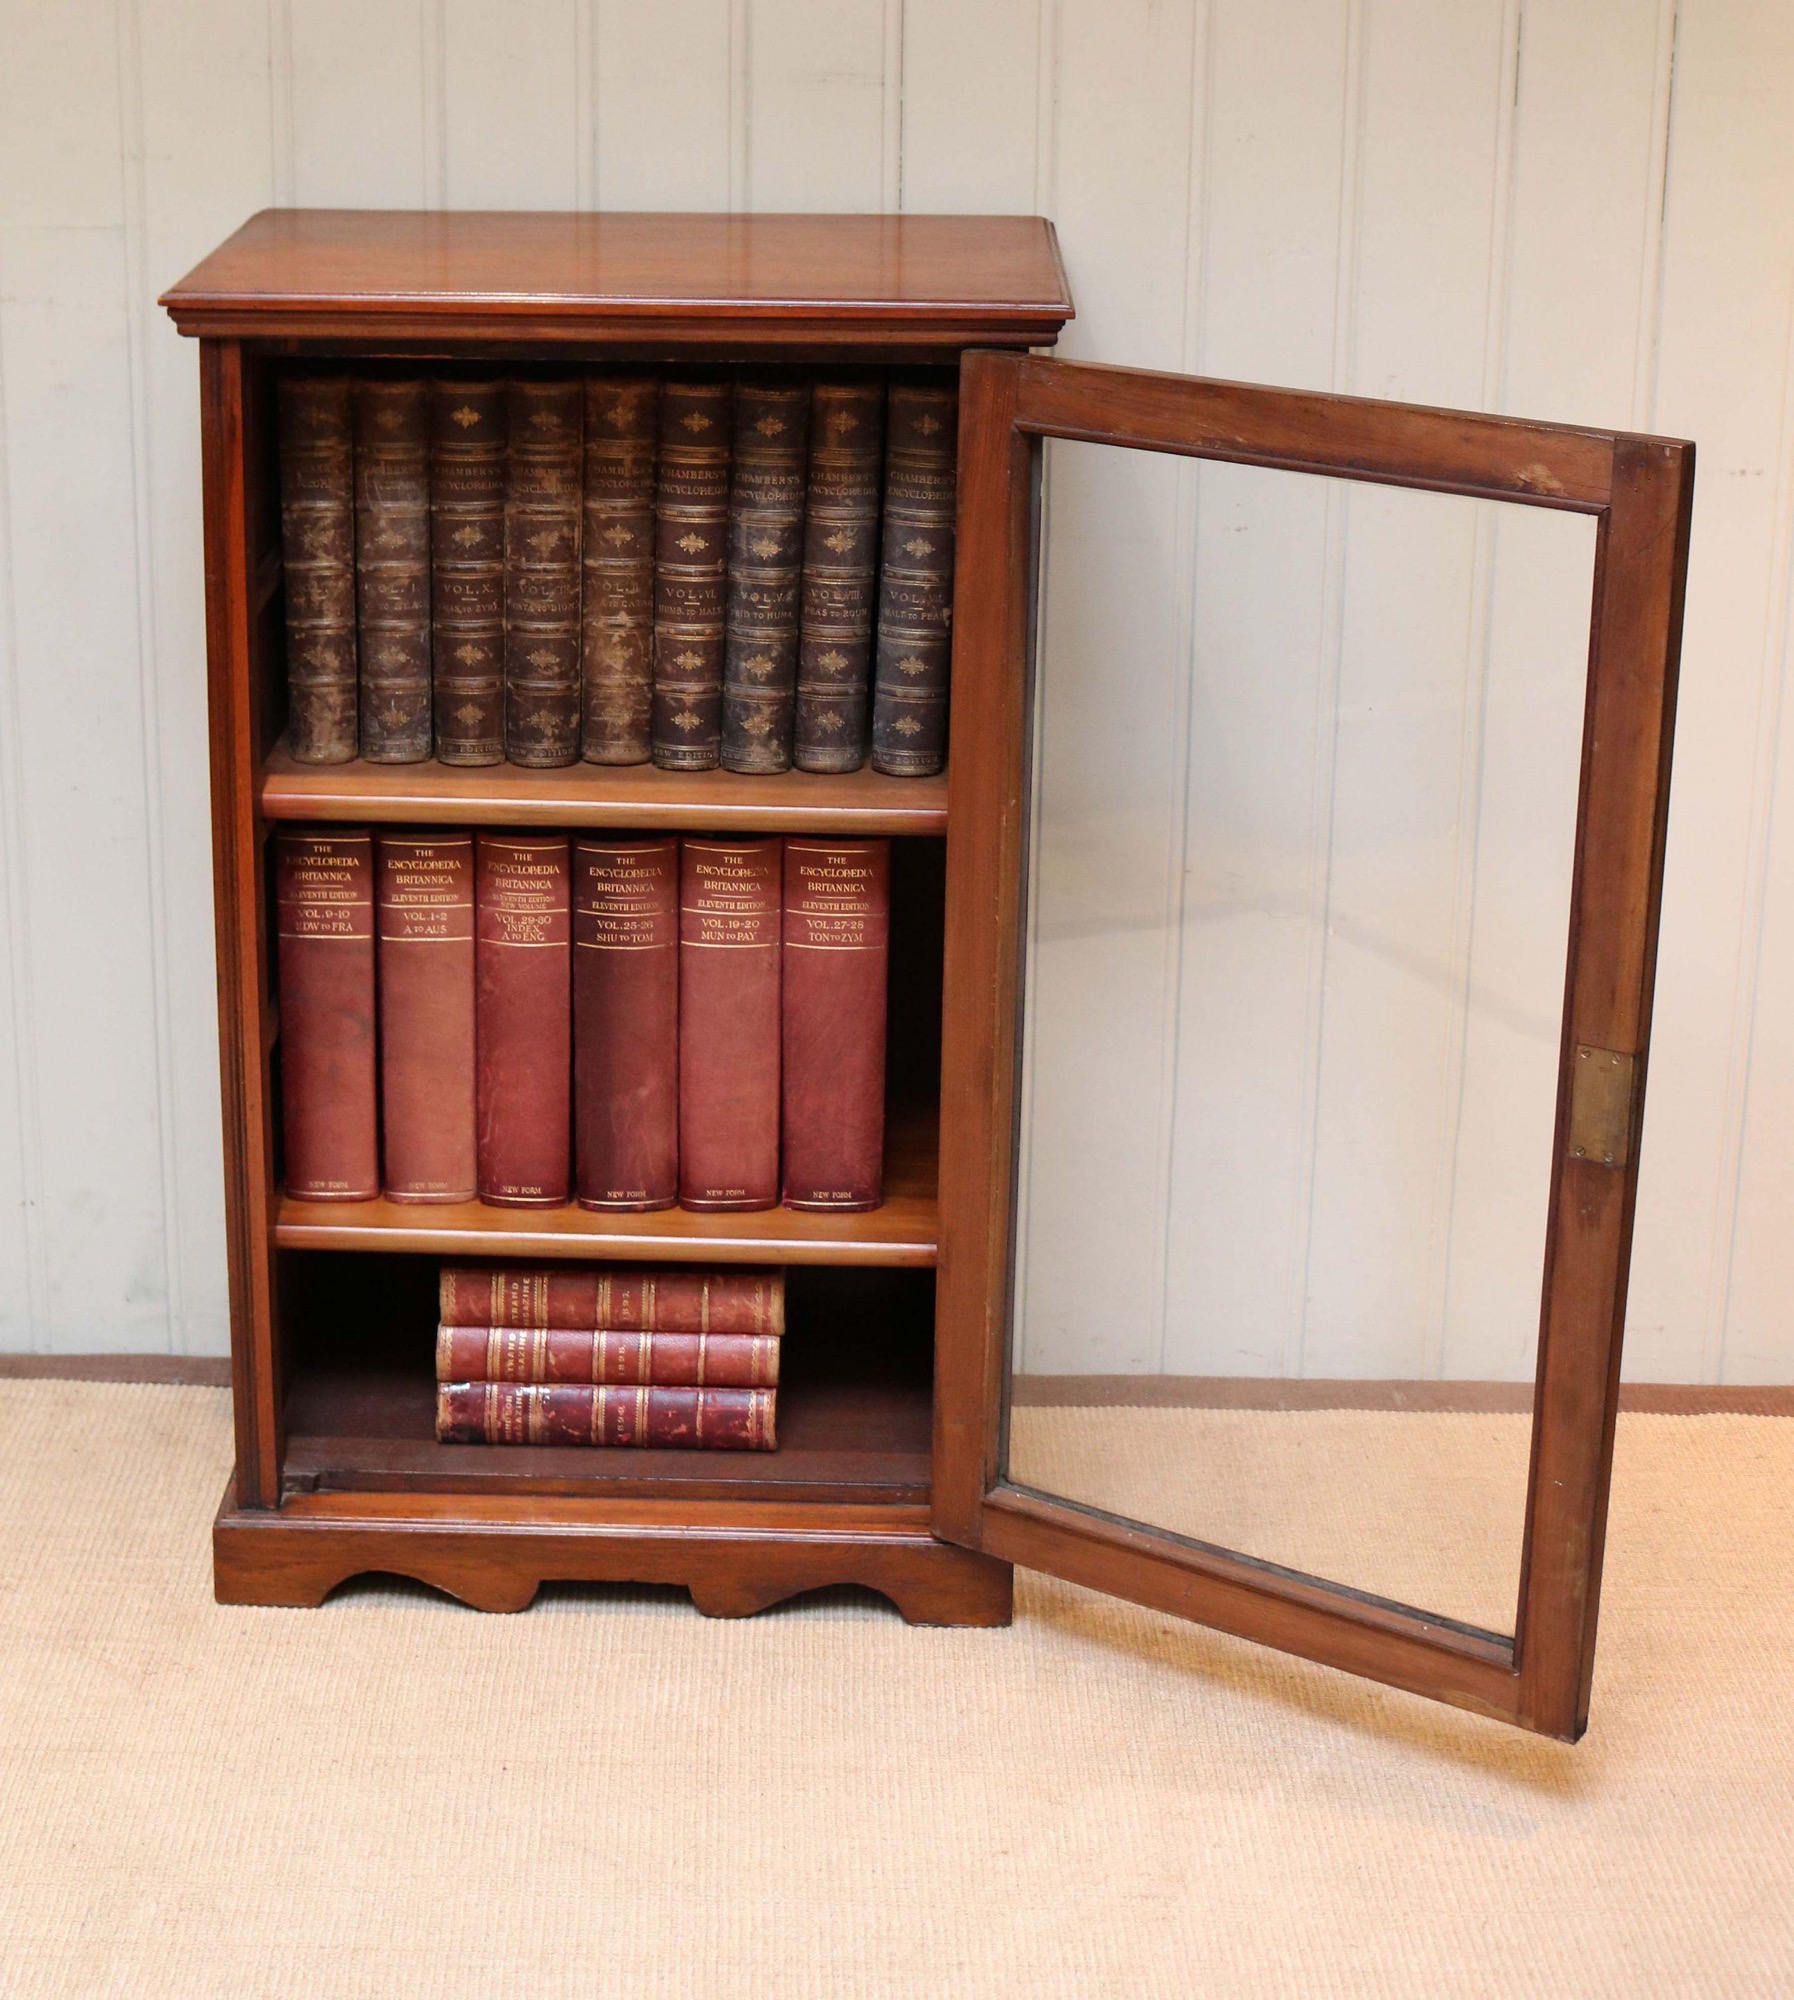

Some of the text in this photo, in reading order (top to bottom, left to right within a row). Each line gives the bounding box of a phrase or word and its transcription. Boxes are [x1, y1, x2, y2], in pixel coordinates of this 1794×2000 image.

[314, 845, 332, 853] THE
[415, 849, 434, 857] THE
[513, 852, 533, 861] THE
[616, 857, 636, 865] THE
[723, 856, 743, 864] THE
[294, 871, 352, 881] BRITANNICA
[396, 875, 454, 884] BRITANNICA
[495, 877, 552, 890] BRITANNICA
[597, 882, 655, 893] BRITANNICA
[704, 880, 761, 892] BRITANNICA
[807, 881, 866, 893] BRITANNICA
[290, 891, 327, 899] EVENTH
[391, 894, 459, 902] ELEVENTH EDITION
[592, 901, 630, 911] ELEVENTH
[697, 899, 735, 910] ELEVENTH
[802, 900, 840, 911] ELEVENTH
[332, 922, 353, 932] FRA
[403, 925, 412, 934] A
[425, 925, 447, 934] AUS
[507, 923, 540, 933] INDEX
[502, 932, 510, 941] A
[596, 933, 618, 942] SHU
[630, 933, 654, 943] TOM
[701, 931, 725, 941] MUN
[737, 932, 755, 942] PAY
[808, 932, 830, 942] TON
[840, 933, 863, 943] ZYM
[502, 1185, 541, 1195] NEW FORM
[607, 1190, 646, 1199] NEW FORM
[706, 1189, 745, 1197] NEW FORM
[813, 1190, 852, 1199] NEW FORM
[511, 1282, 519, 1324] TRAND
[506, 1332, 516, 1376] TRAND
